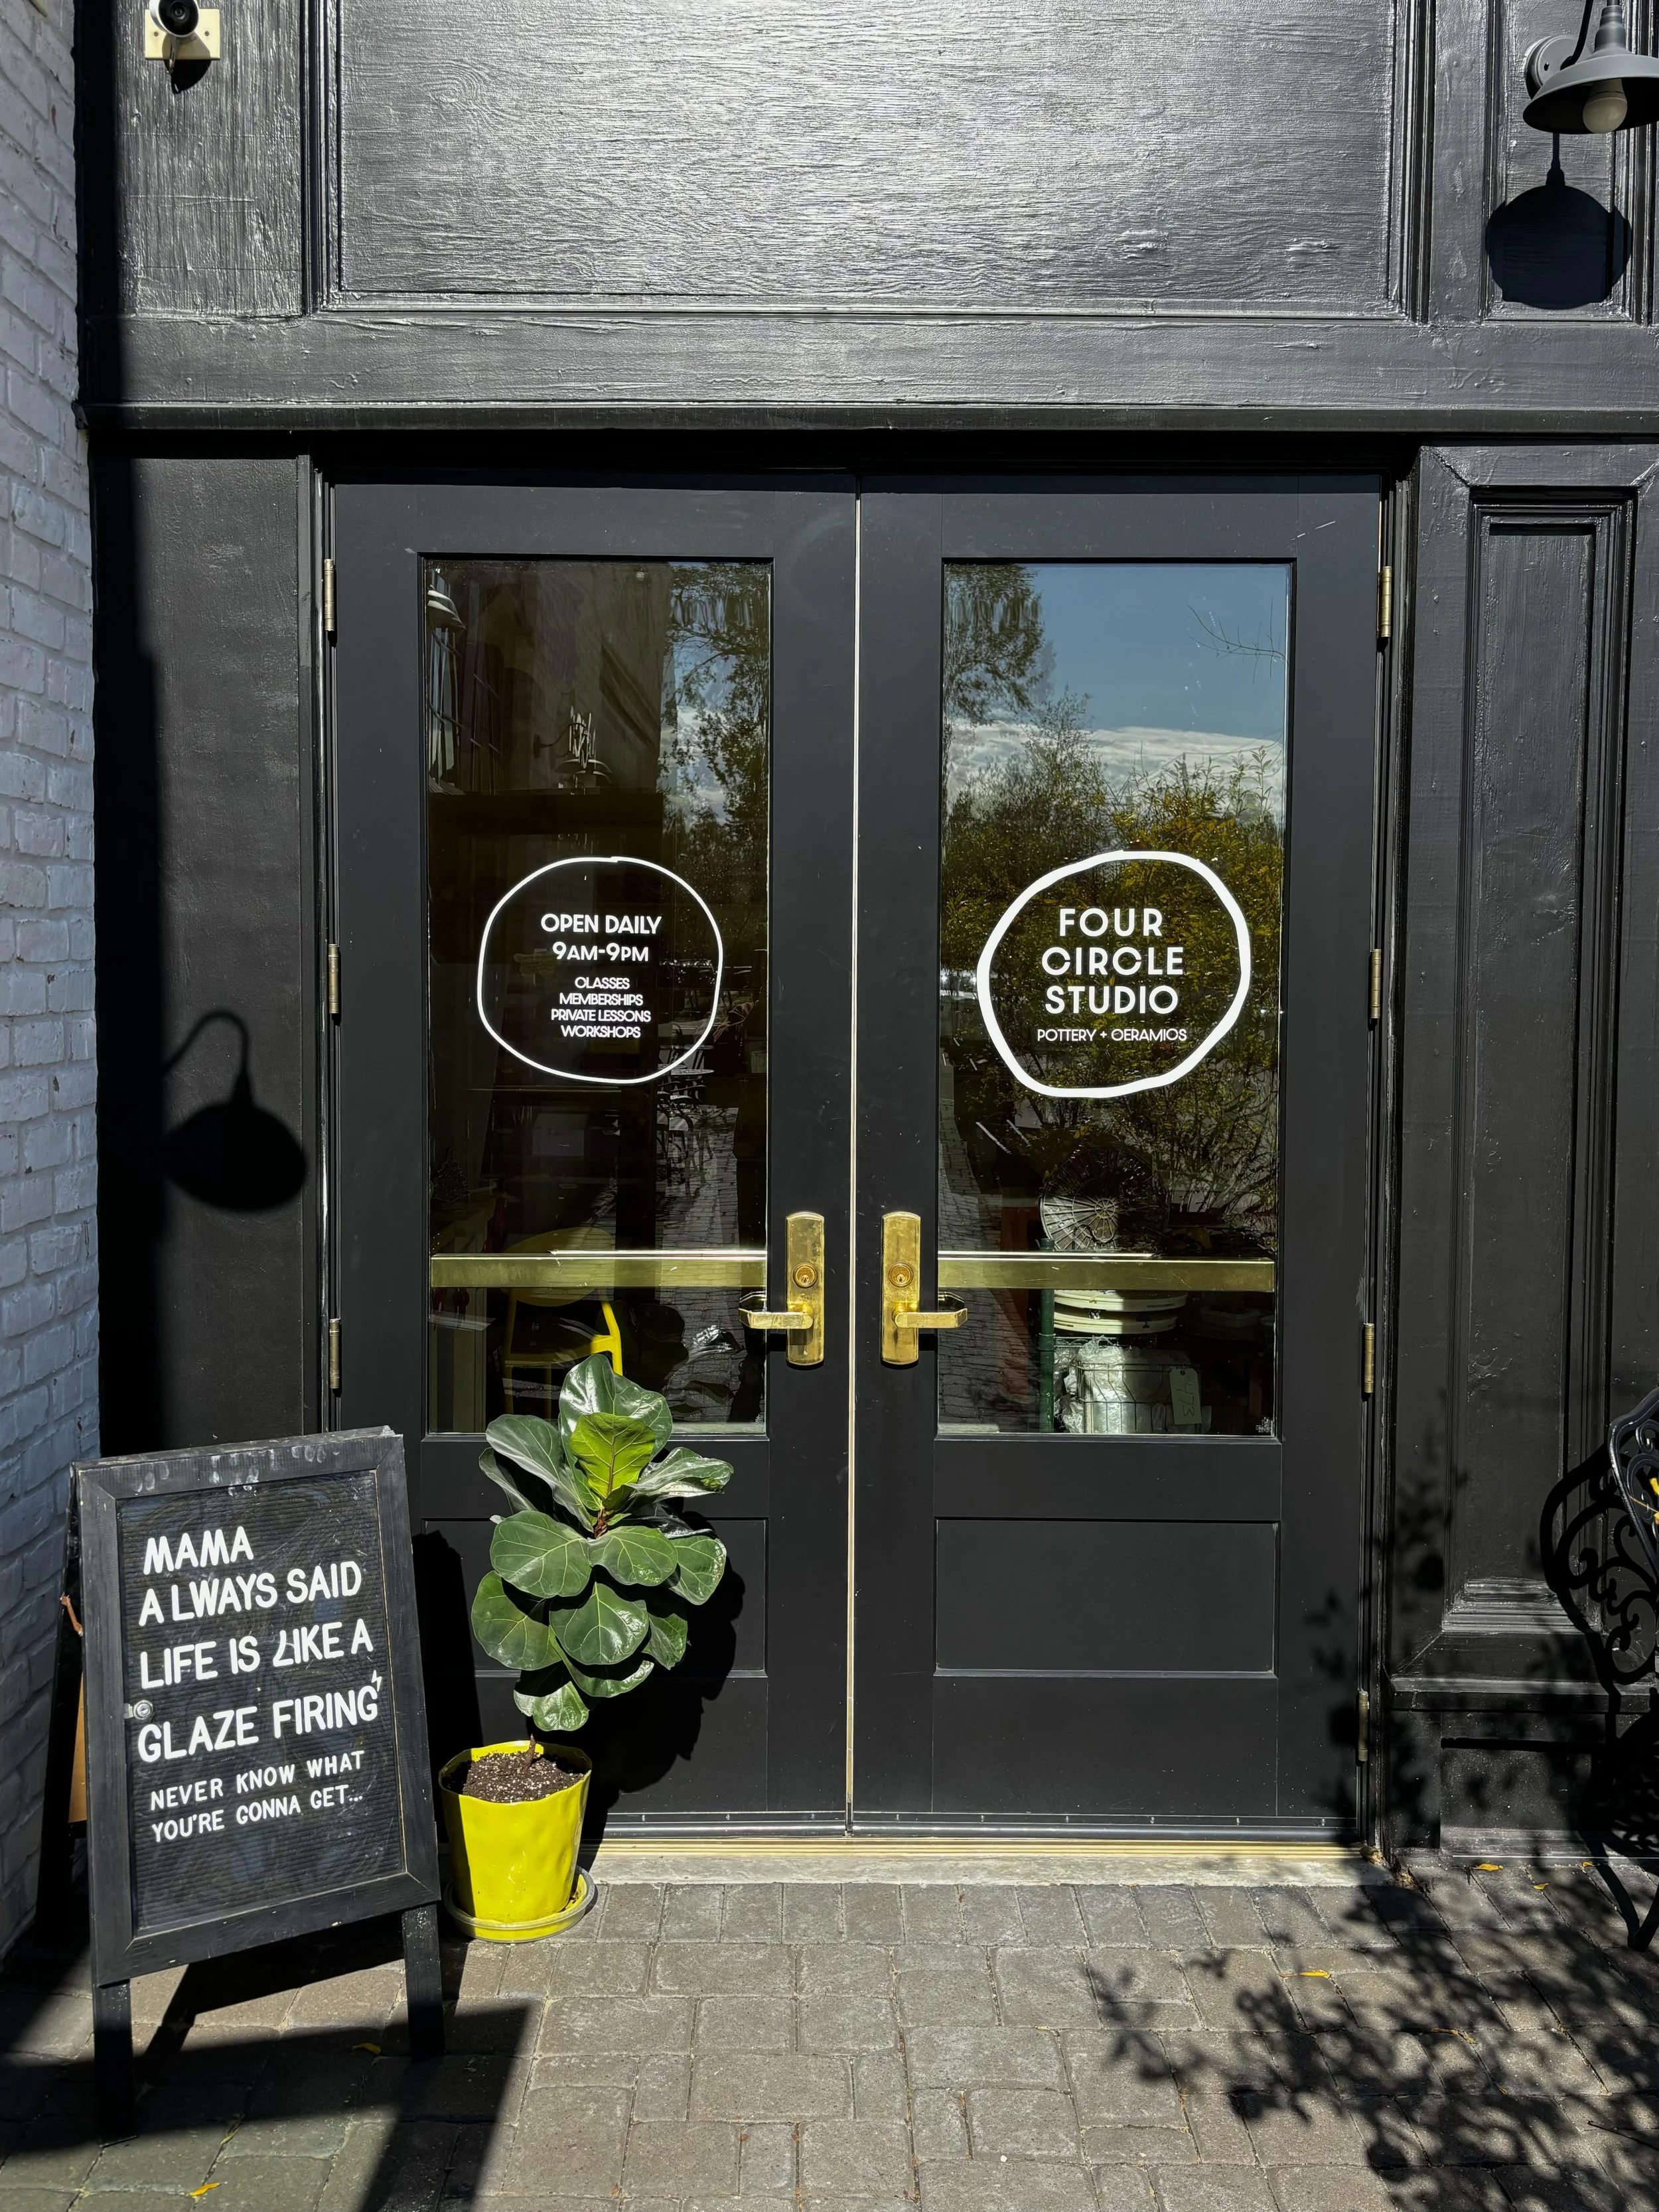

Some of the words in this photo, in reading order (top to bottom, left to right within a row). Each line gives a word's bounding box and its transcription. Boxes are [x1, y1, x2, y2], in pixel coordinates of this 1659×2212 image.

[540, 913, 599, 933] OPEN
[605, 914, 662, 934] DAILY
[1059, 908, 1163, 937] FOUR
[552, 941, 649, 962] 9AM-9PM
[1041, 946, 1184, 976] CIRCLE
[574, 976, 630, 990] CLASSES
[559, 992, 644, 1006] MEMBERSHIPS
[1045, 985, 1179, 1014] STUDIO
[551, 1008, 597, 1022] PRIVATE
[598, 1009, 652, 1022] LESSONS
[560, 1024, 641, 1038] WORKSHOPS
[1037, 1028, 1097, 1042] POTTERY
[1111, 1028, 1187, 1042] CERAMICS
[1175, 1383, 1195, 1417] 473
[143, 1525, 254, 1575] MAMA
[139, 1572, 278, 1627] ALWAYS
[286, 1560, 362, 1604] SAID
[140, 1641, 218, 1689] LIFE
[229, 1635, 261, 1675] IS
[272, 1622, 344, 1667] LIKE
[350, 1618, 374, 1655] A
[137, 1706, 259, 1763] GLAZE
[272, 1685, 378, 1739] FIRING
[151, 1778, 224, 1811] NEVER
[236, 1763, 295, 1794] KNOW
[306, 1750, 365, 1779] WHAT
[151, 1809, 225, 1842] YOU'RE
[236, 1795, 301, 1825] GONNA
[310, 1784, 364, 1809] GET...
